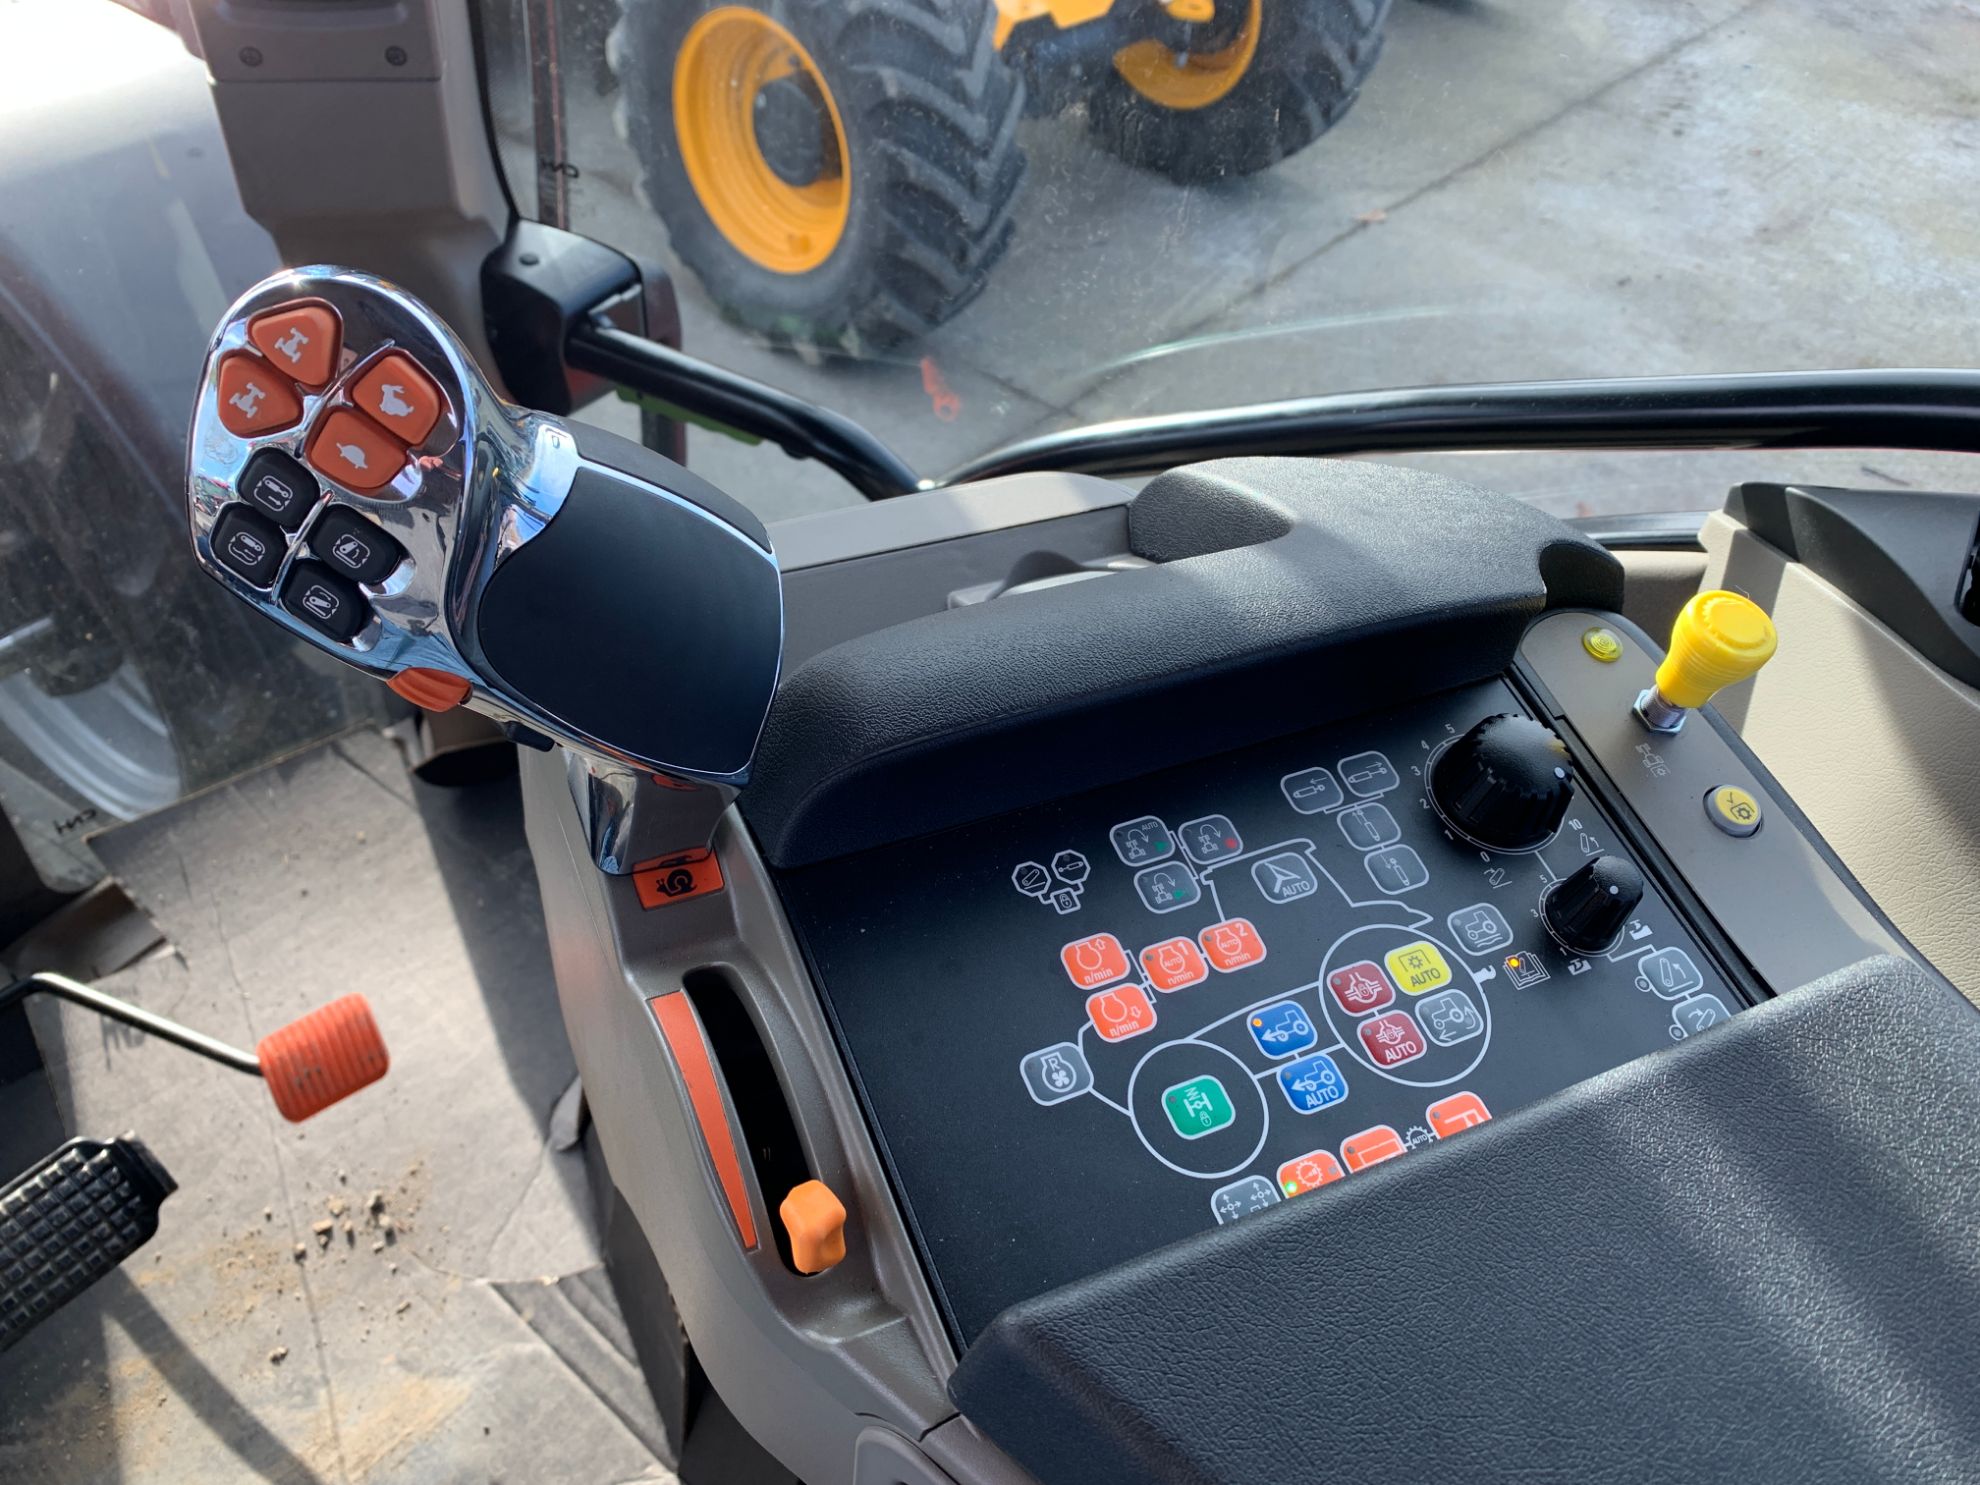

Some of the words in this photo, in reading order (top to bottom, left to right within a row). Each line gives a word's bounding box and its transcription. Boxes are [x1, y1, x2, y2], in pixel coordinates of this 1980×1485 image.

[1444, 723, 1456, 734] 5
[1420, 739, 1430, 751] 4
[1410, 765, 1421, 777] 3
[1419, 798, 1430, 809] 2
[1141, 820, 1159, 832] AUTO
[1567, 818, 1583, 831] 10
[1444, 829, 1454, 840] 1
[1480, 851, 1491, 863] 0
[1538, 873, 1548, 884] 5
[1281, 880, 1311, 898] AUTO
[1530, 908, 1539, 918] 3
[1235, 922, 1249, 937] 2
[1178, 942, 1189, 956] 1
[1220, 938, 1241, 950] AUTO
[1559, 947, 1568, 957] 1
[1163, 956, 1183, 969] AUTO
[1223, 952, 1252, 967] n/min
[1083, 967, 1114, 985] n/min
[1166, 970, 1195, 986] n/min
[1409, 967, 1442, 988] AUTO
[1108, 1020, 1140, 1038] n/min
[1383, 1040, 1418, 1064] AUTO
[1047, 1057, 1061, 1072] R
[1304, 1085, 1340, 1109] AUTO
[1411, 1133, 1429, 1145] AUTO
